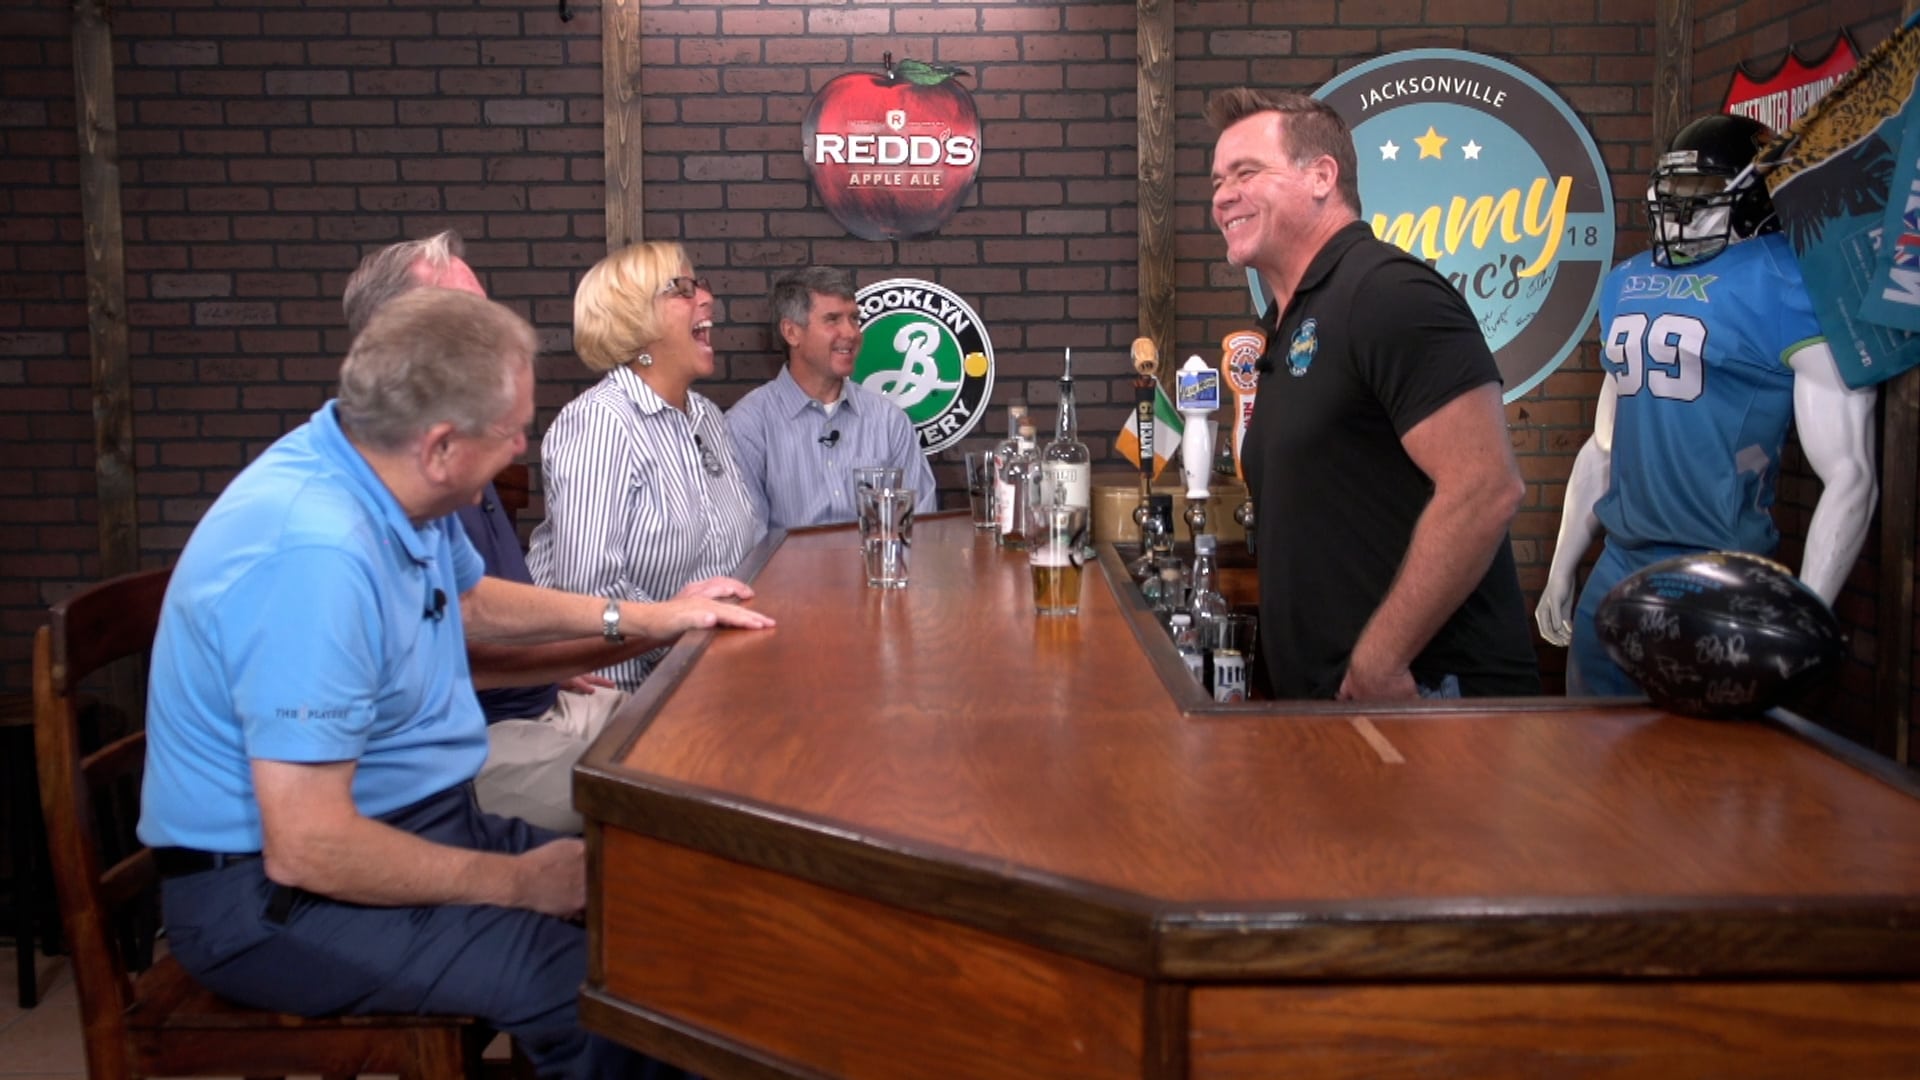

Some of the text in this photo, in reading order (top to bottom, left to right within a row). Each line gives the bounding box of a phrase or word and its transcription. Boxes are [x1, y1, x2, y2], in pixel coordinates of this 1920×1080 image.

[1360, 76, 1507, 111] JACKSONVILLE
[816, 129, 976, 165] REDD'S
[849, 173, 940, 185] APPLE ALE
[1371, 176, 1573, 278] mmy
[1567, 226, 1598, 247] 18
[1446, 253, 1526, 299] ac's
[857, 289, 970, 334] ROOKLYN
[1605, 312, 1708, 402] 99
